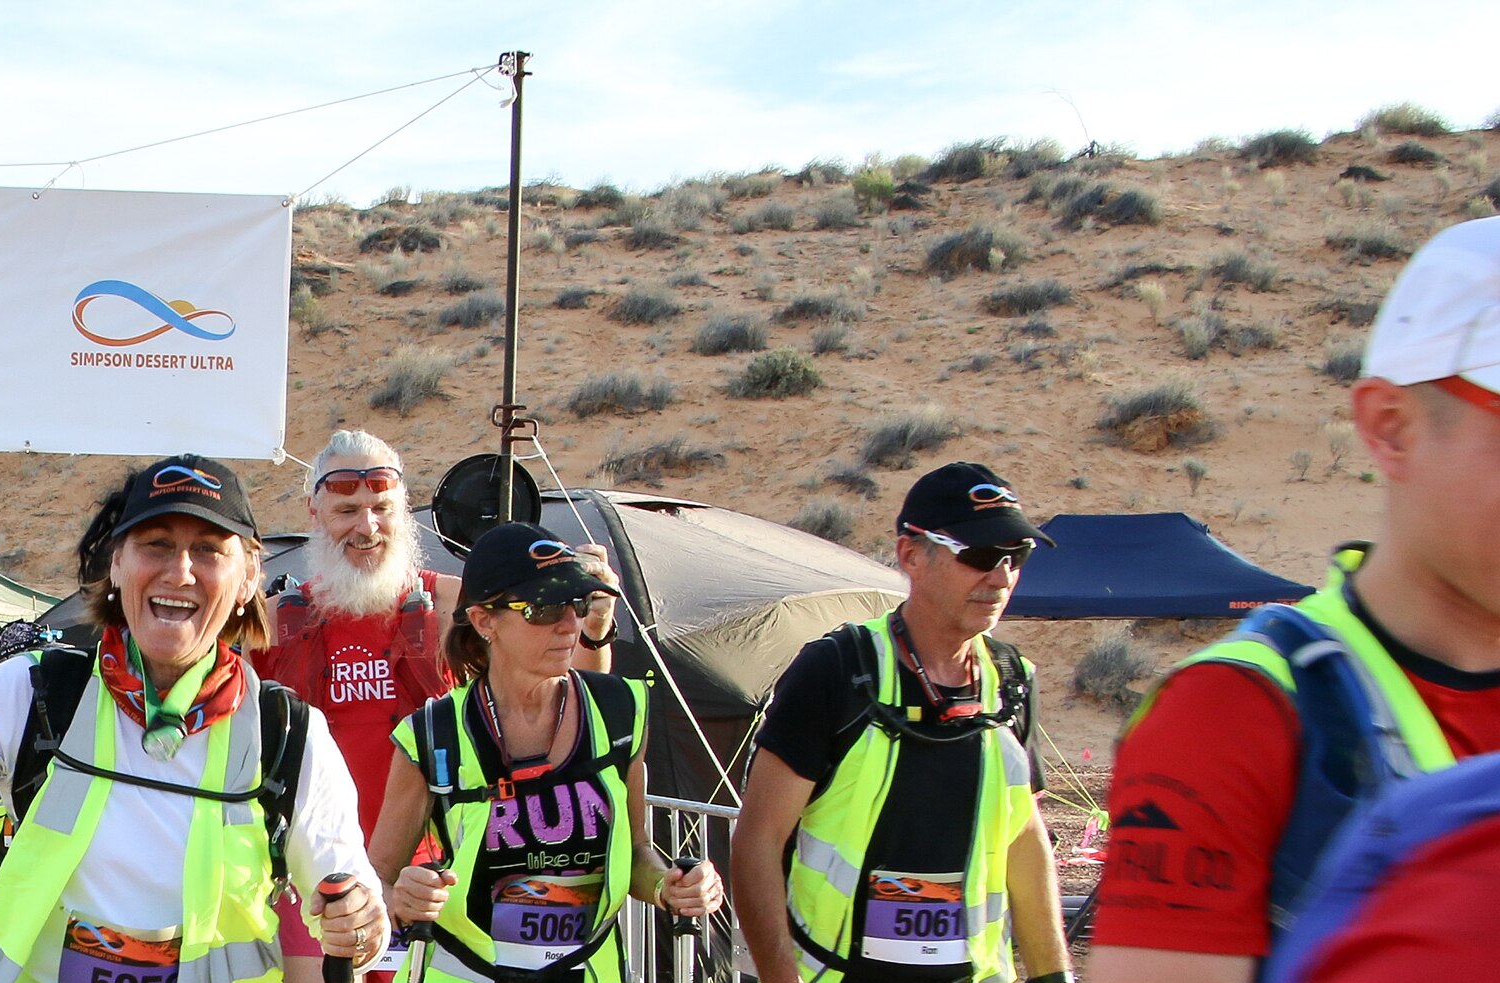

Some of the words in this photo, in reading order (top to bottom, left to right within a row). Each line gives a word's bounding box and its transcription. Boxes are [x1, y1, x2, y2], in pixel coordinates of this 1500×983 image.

[70, 351, 133, 369] SIMPSON
[135, 353, 188, 370] DESERT
[190, 355, 235, 372] ULTRA
[486, 781, 613, 851] RUN
[527, 850, 570, 870] like
[573, 851, 591, 865] a
[519, 911, 587, 942] 5062
[893, 906, 961, 938] 5061
